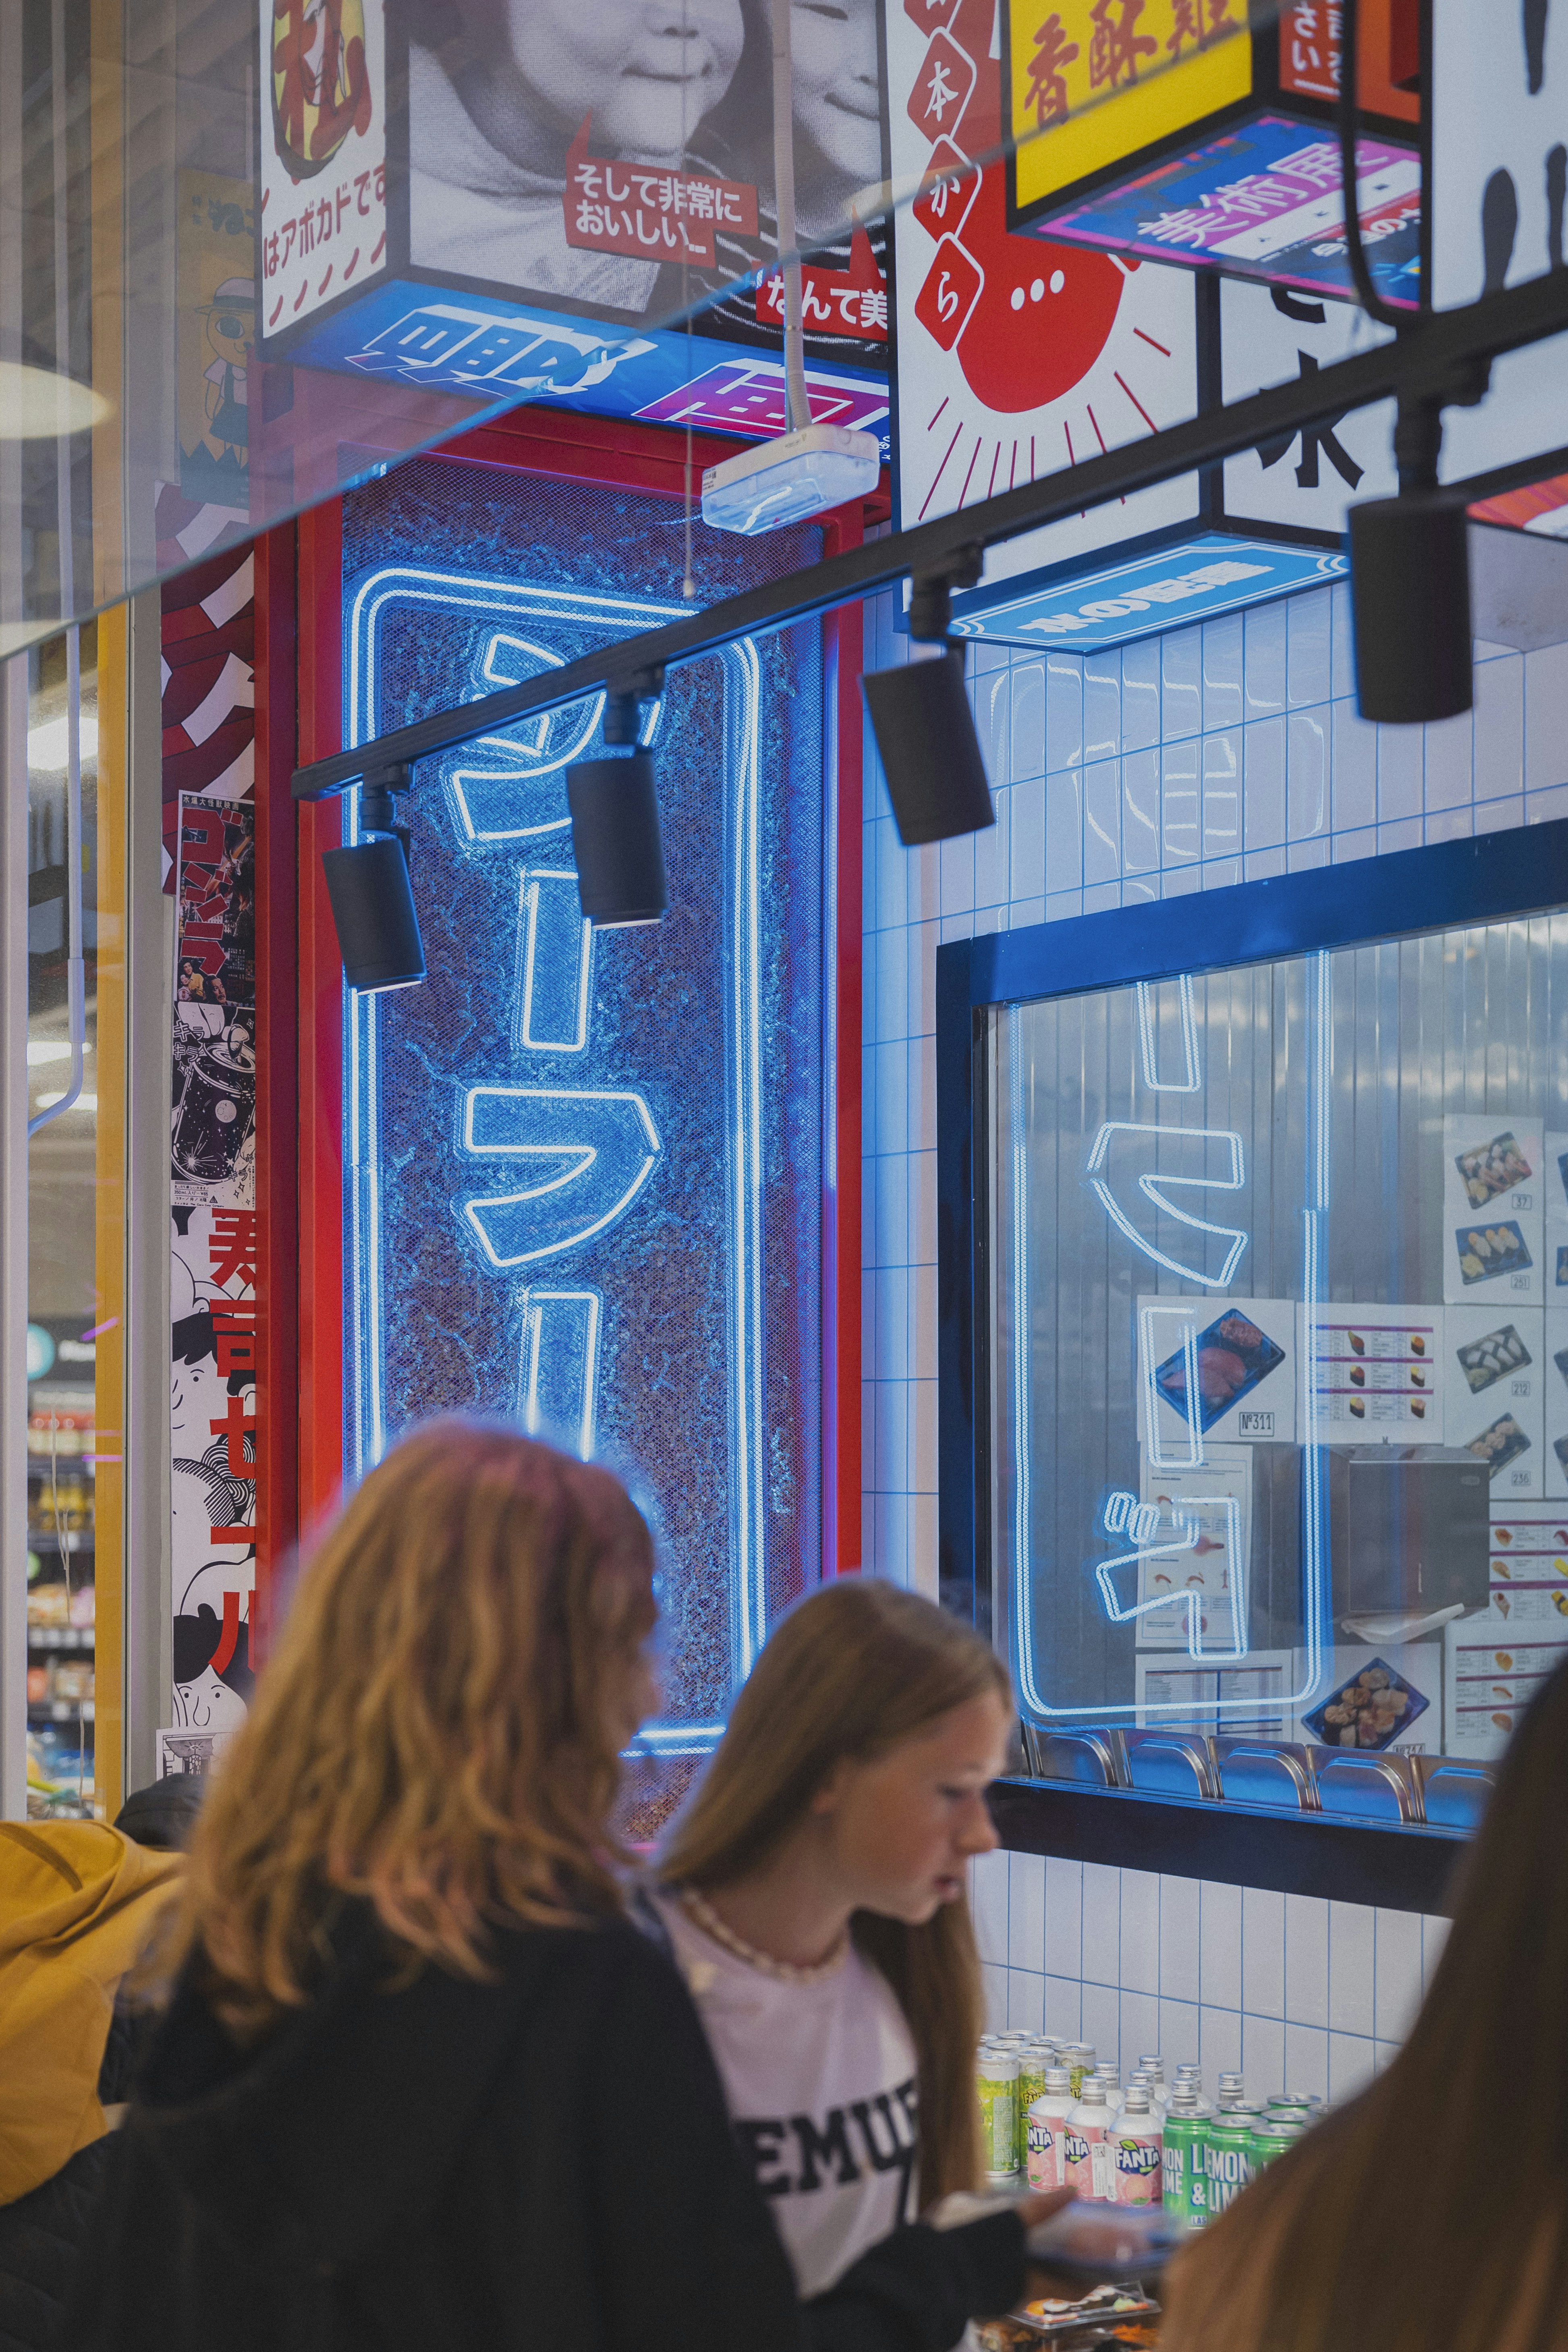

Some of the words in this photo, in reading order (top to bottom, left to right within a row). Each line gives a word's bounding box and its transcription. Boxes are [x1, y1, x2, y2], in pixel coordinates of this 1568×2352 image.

[924, 0, 960, 323] 本から
[574, 162, 742, 222] そして非常に
[1115, 2146, 1161, 2169] FANTA
